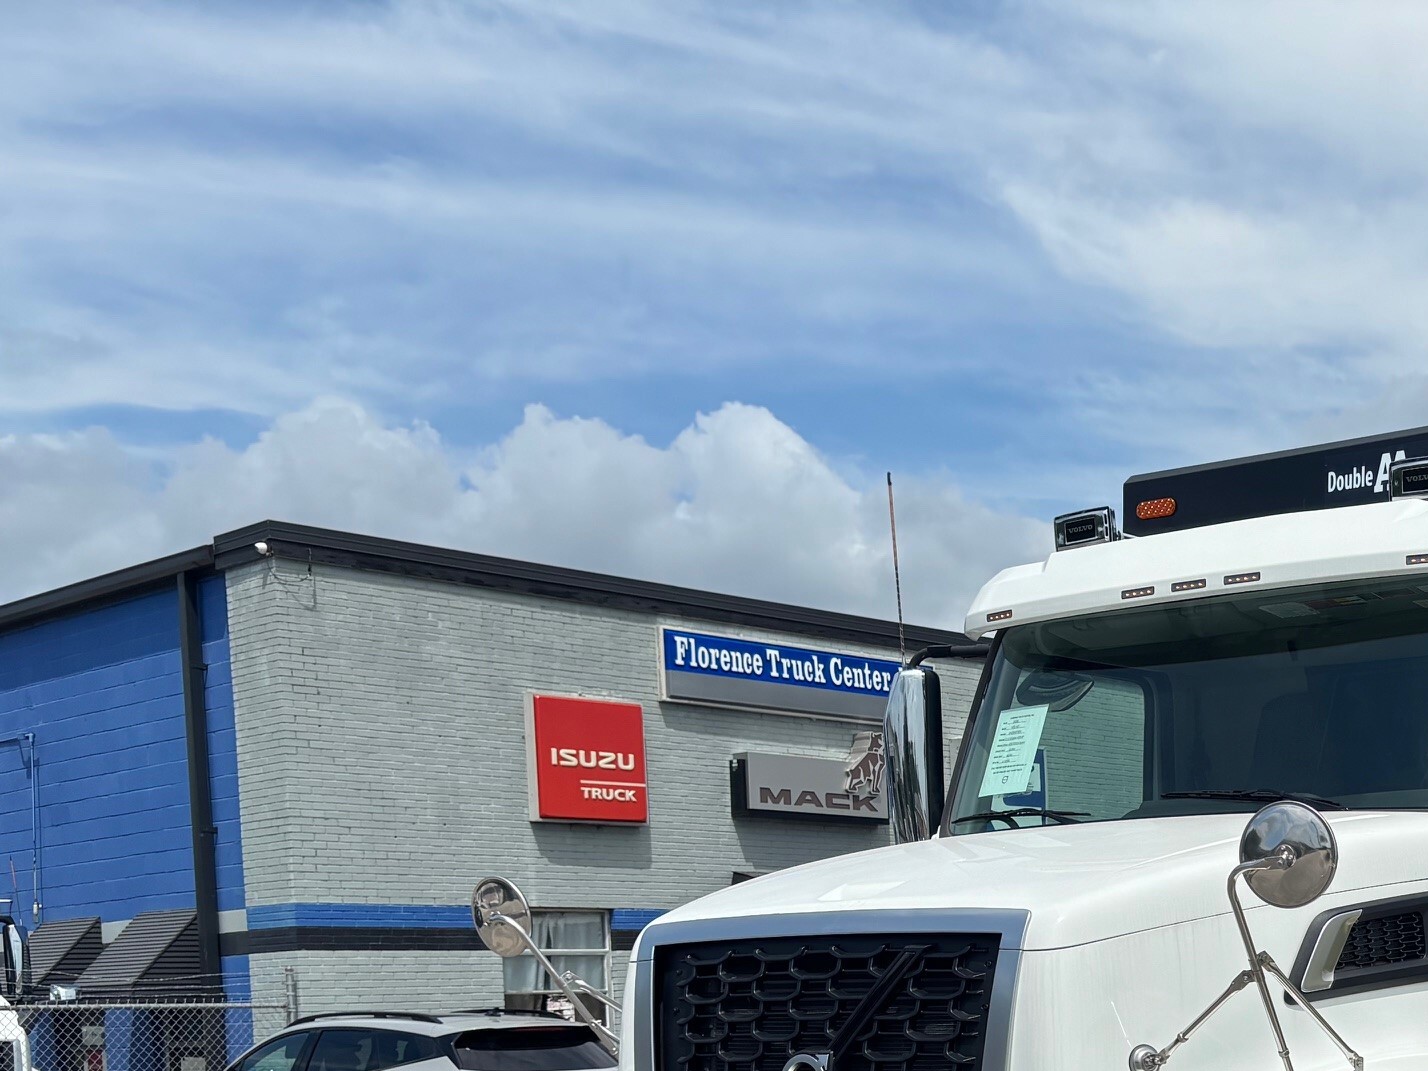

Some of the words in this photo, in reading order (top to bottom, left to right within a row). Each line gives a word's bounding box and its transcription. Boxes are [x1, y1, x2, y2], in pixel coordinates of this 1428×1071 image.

[1327, 465, 1374, 493] Double
[1373, 450, 1406, 493] A
[1067, 524, 1093, 534] VOLVO
[673, 635, 763, 675] Florence
[766, 648, 827, 683] Truck
[829, 657, 891, 692] Center
[550, 747, 635, 771] ISUZU
[580, 786, 637, 802] TRUCK
[759, 787, 879, 812] MACK
